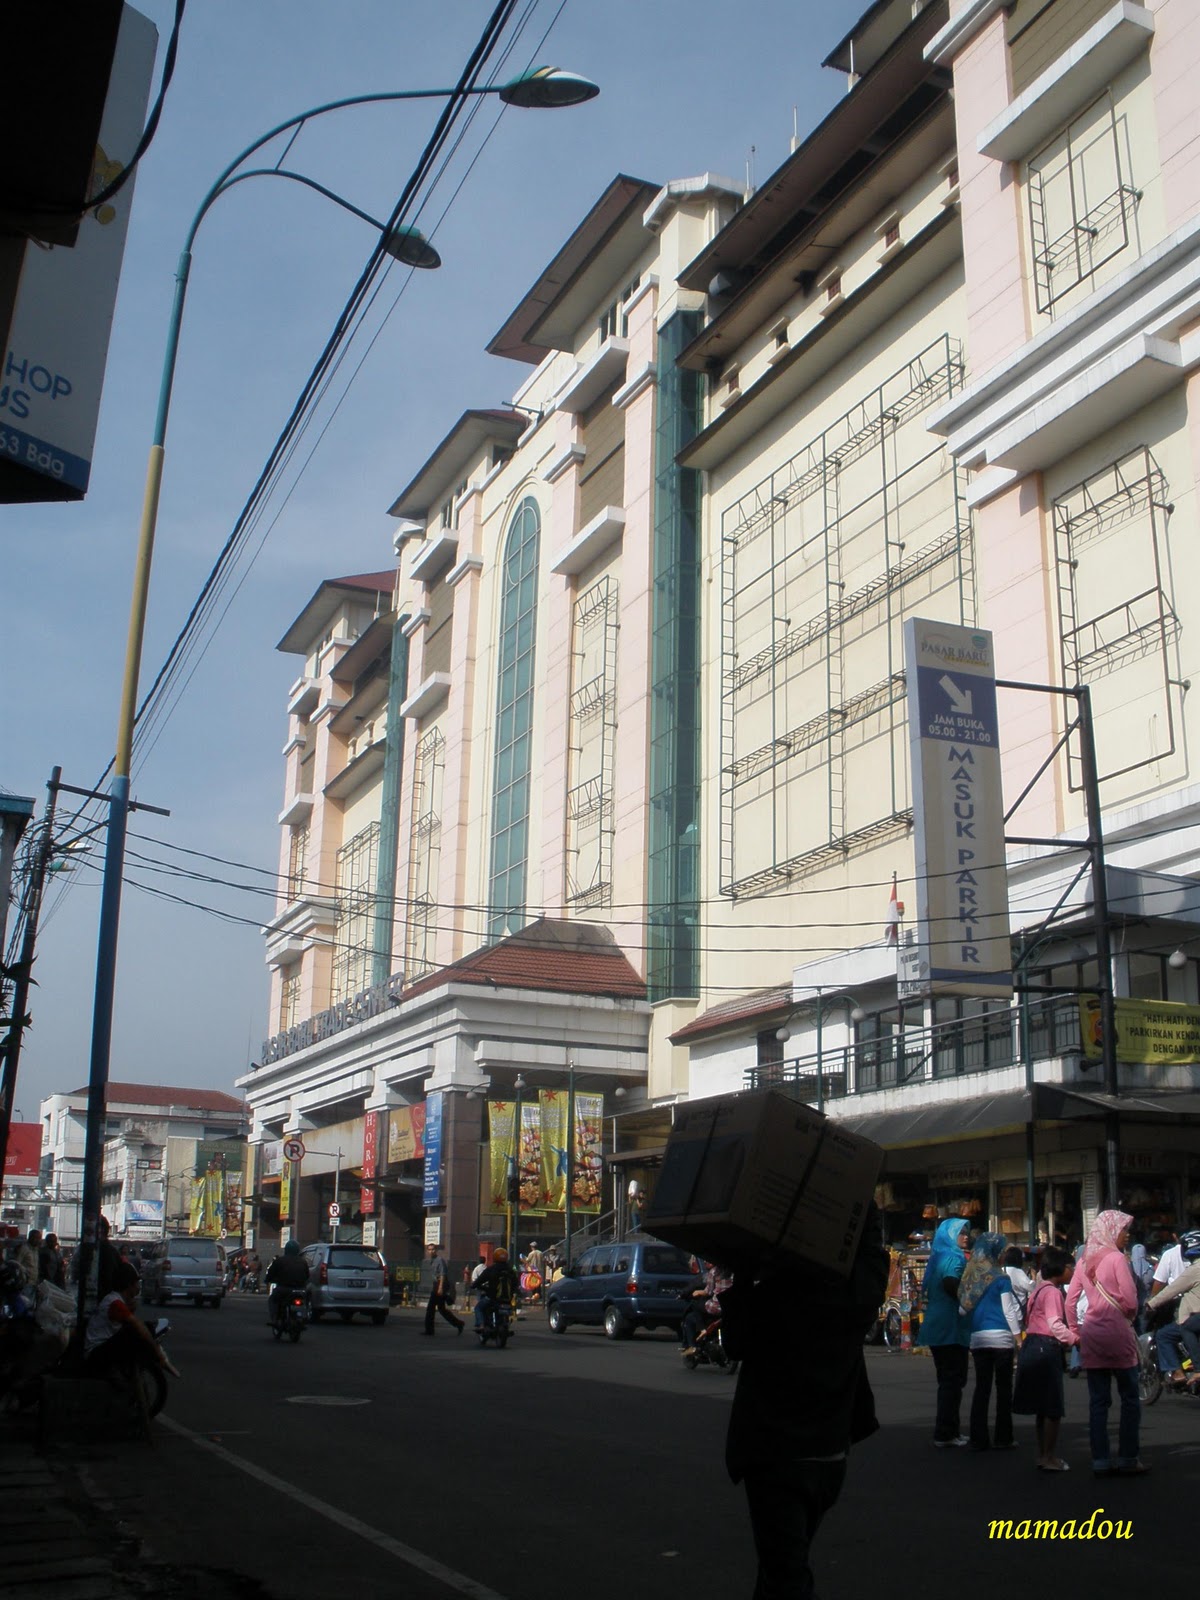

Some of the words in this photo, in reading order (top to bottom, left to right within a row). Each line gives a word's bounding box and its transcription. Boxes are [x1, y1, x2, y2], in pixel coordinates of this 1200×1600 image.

[26, 442, 66, 479] Bdg
[921, 641, 956, 658] PASAR
[958, 646, 988, 662] BARU
[928, 724, 956, 737] 05.00
[964, 729, 991, 743] 21.00
[933, 713, 955, 726] JAM
[957, 718, 985, 731] BUKA
[948, 745, 977, 840] MASUK
[955, 848, 981, 964] PARKIR
[315, 999, 352, 1042] TRADE
[1153, 1043, 1185, 1055] DENGAN
